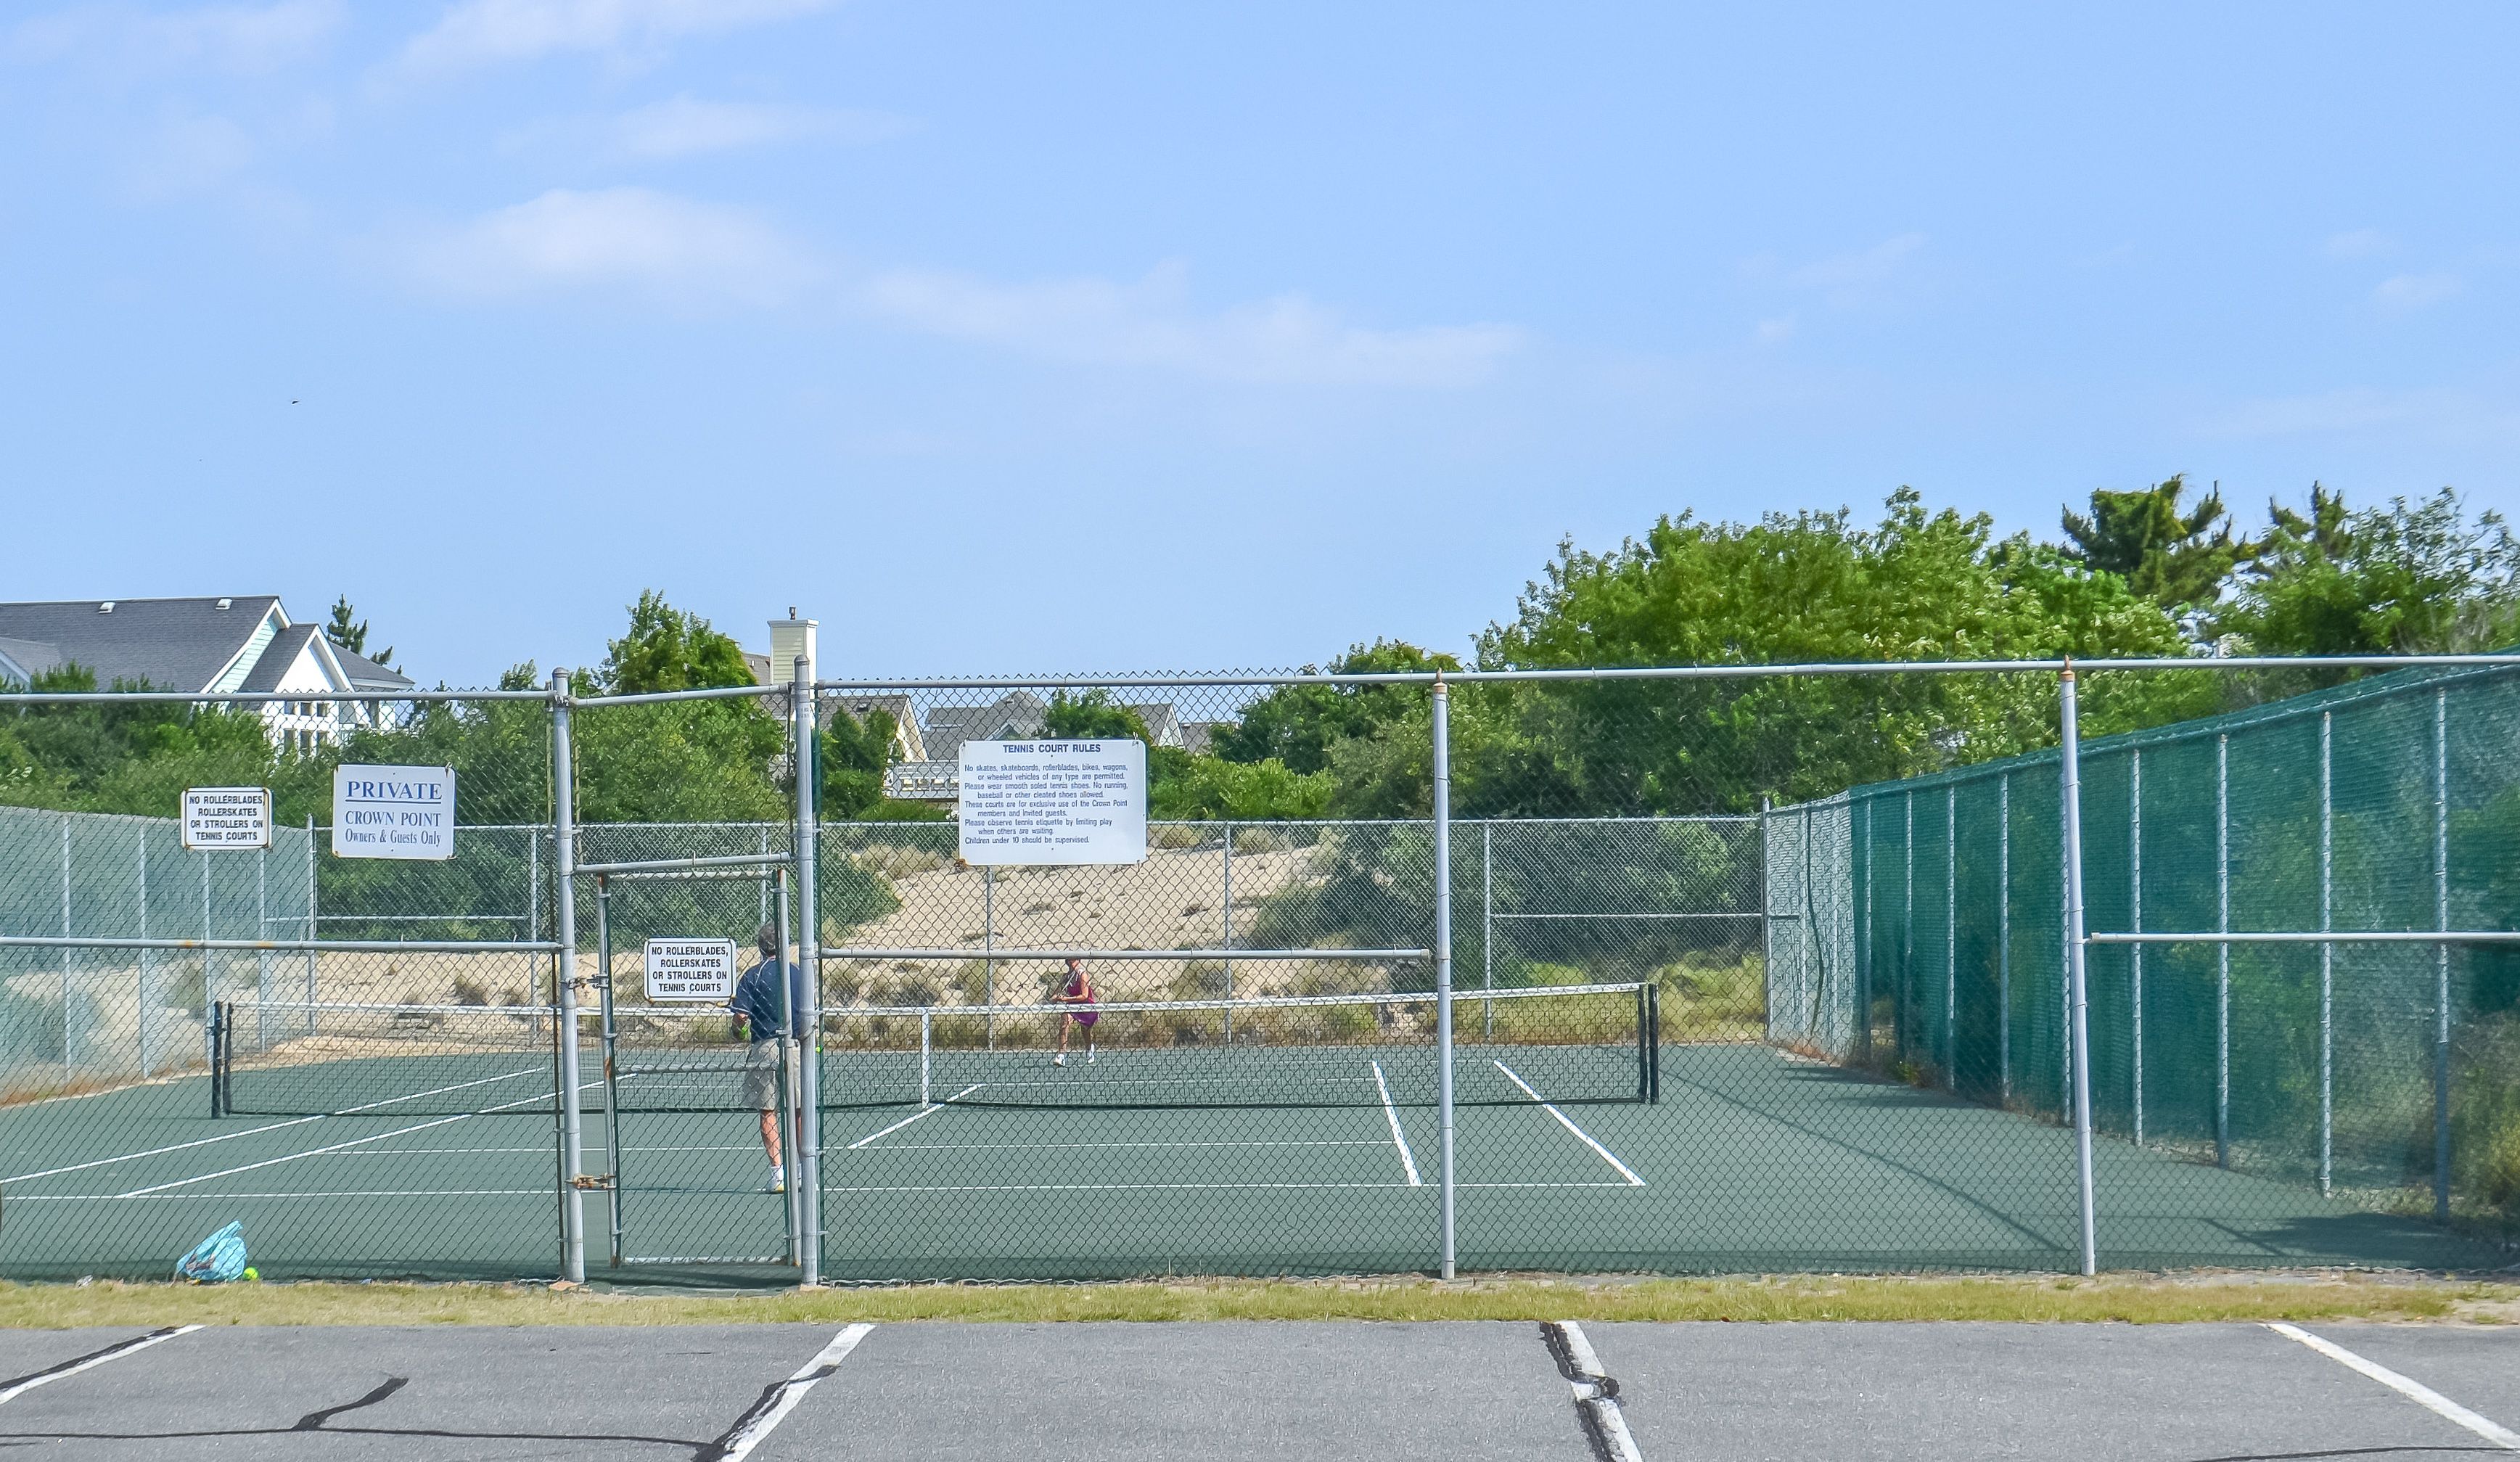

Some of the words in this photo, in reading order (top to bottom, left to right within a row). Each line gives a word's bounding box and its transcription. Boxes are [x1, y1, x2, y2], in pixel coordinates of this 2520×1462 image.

[1003, 744, 1034, 753] TENNIS
[1039, 744, 1068, 753] COURT
[1072, 744, 1101, 752] RULES
[1001, 763, 1041, 772] skateboards,
[347, 781, 443, 800] PRIVATE
[345, 810, 395, 825] CROWN
[401, 813, 441, 826] POINT
[1076, 818, 1097, 826] limiting
[345, 829, 376, 842] Owners
[379, 829, 387, 842] &
[390, 830, 417, 844] Guests
[421, 831, 441, 847] Only
[666, 946, 728, 957] ROLLERBLADES,
[653, 971, 663, 980] OR
[668, 971, 712, 980] STROLLERS
[716, 971, 727, 980] ON
[659, 983, 685, 992] TENNIS
[689, 983, 721, 992] COURTS
